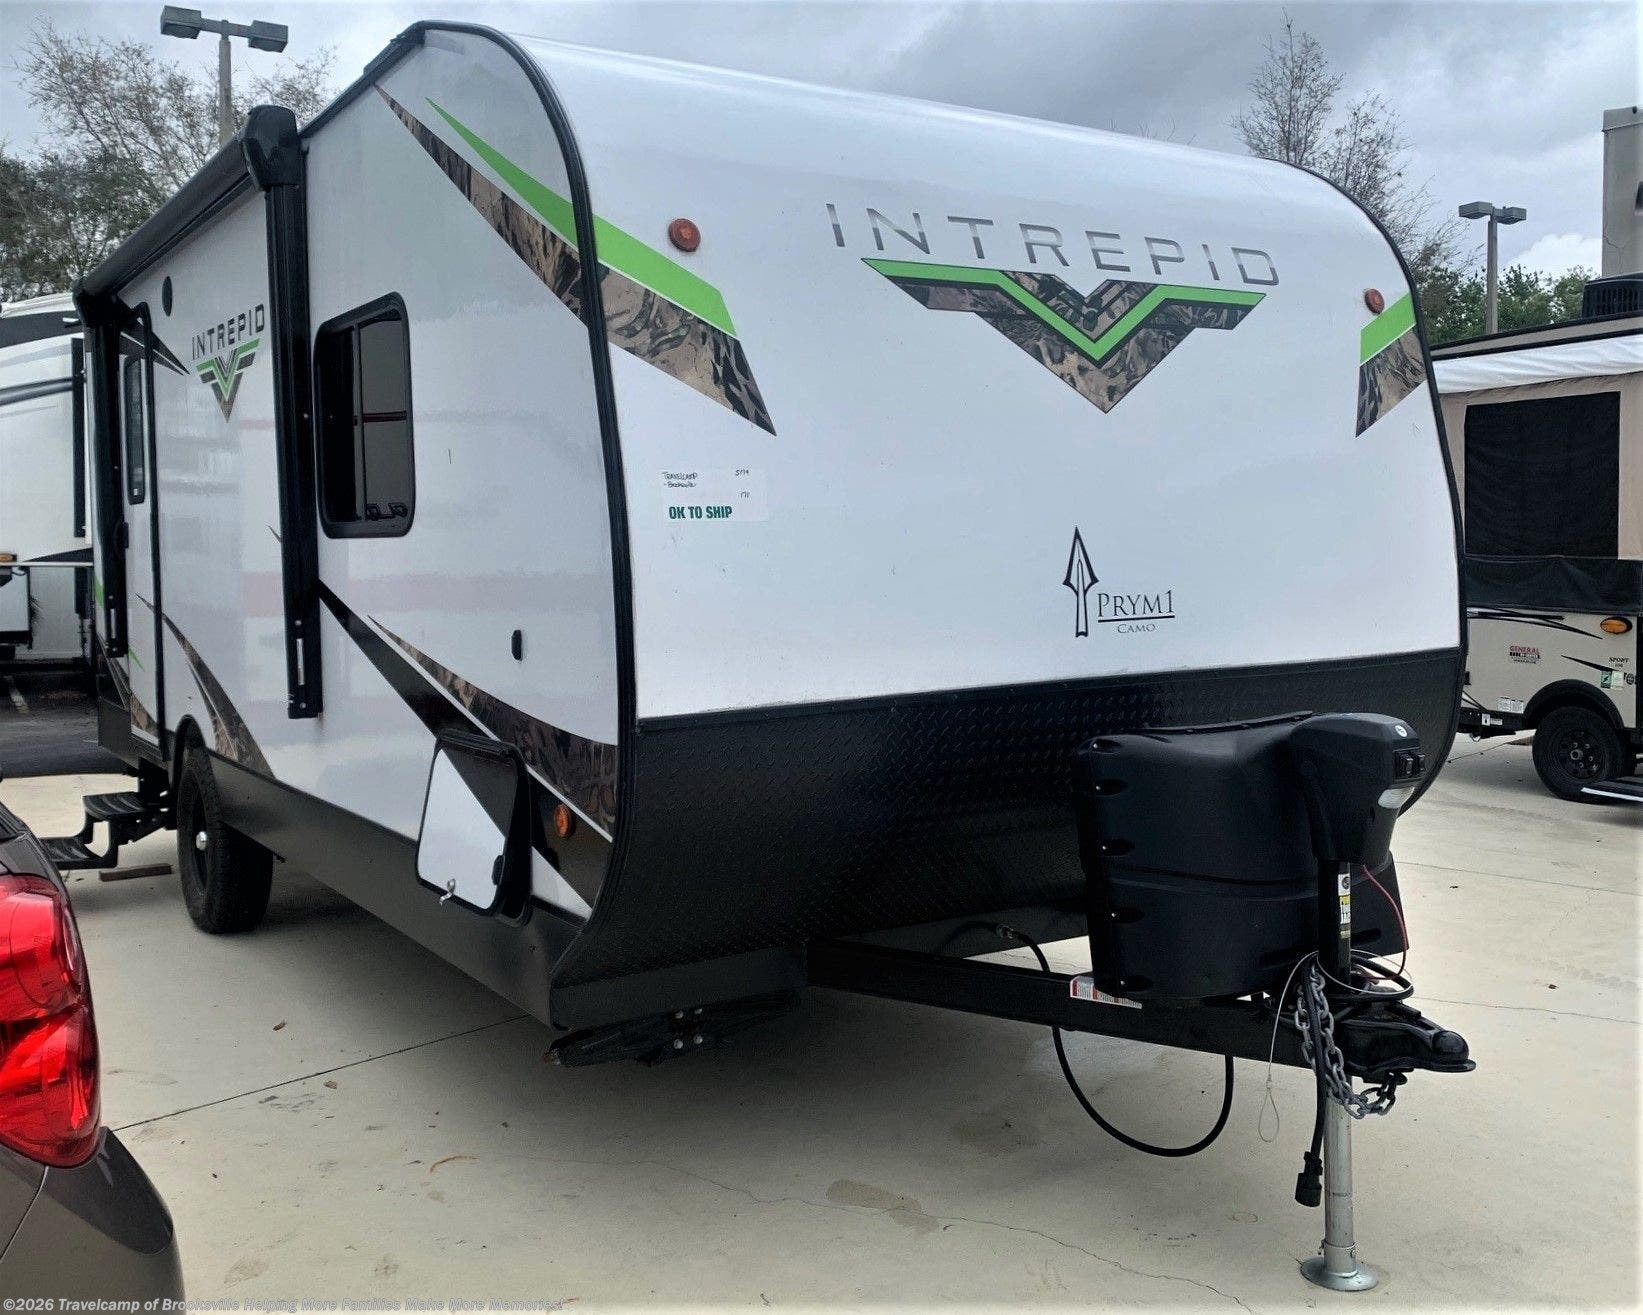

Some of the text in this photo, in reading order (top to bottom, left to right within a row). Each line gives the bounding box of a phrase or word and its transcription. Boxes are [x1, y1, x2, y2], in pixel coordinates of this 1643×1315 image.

[826, 203, 1279, 286] INTREPID
[192, 304, 265, 360] INTREPID
[668, 505, 733, 519] OK TO SHIP
[1097, 589, 1175, 618] PRYM1
[1117, 623, 1156, 634] CAMO
[1509, 645, 1540, 655] GENERAL
